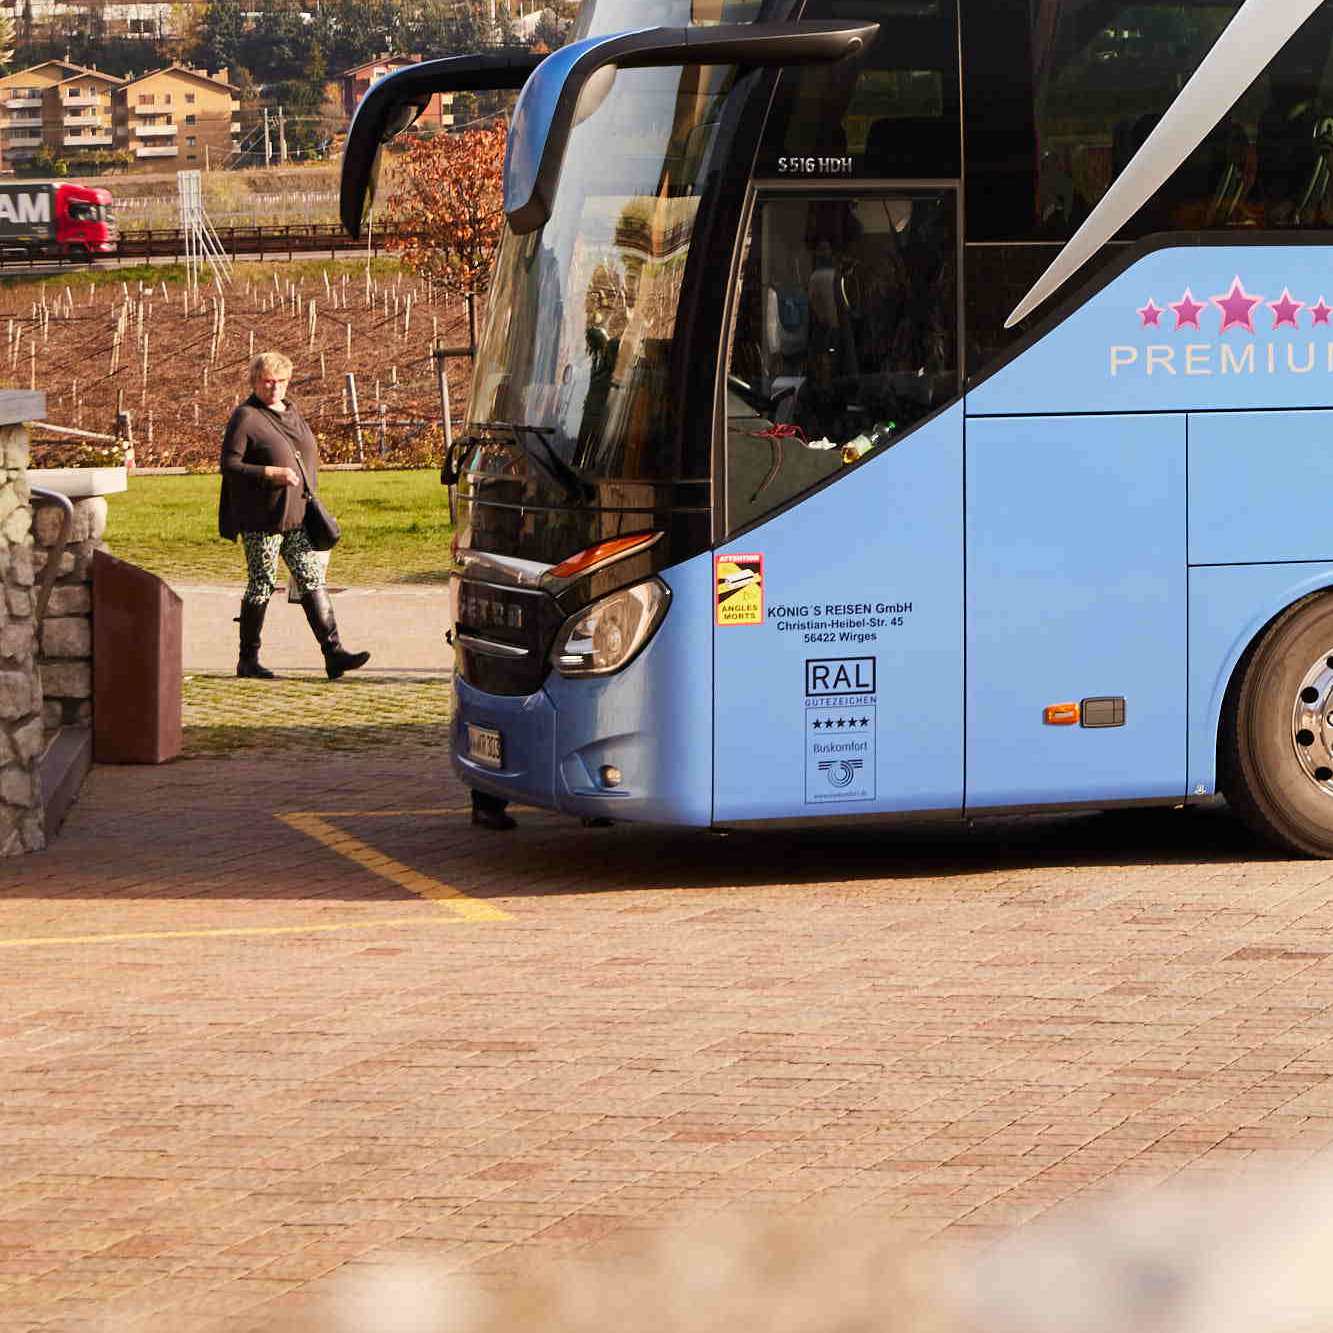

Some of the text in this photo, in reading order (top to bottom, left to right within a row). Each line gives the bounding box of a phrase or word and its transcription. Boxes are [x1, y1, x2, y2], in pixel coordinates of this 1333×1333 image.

[777, 157, 788, 172] S
[817, 157, 853, 173] HDH
[722, 604, 758, 612] ANGLES
[825, 603, 872, 615] REISEN
[875, 602, 912, 614] GmbH
[776, 616, 904, 631] Christian-Heibel-Str. 45
[804, 631, 877, 643] 56422 Wirges
[812, 663, 870, 691] RAL
[814, 741, 868, 754] Buskomfort
